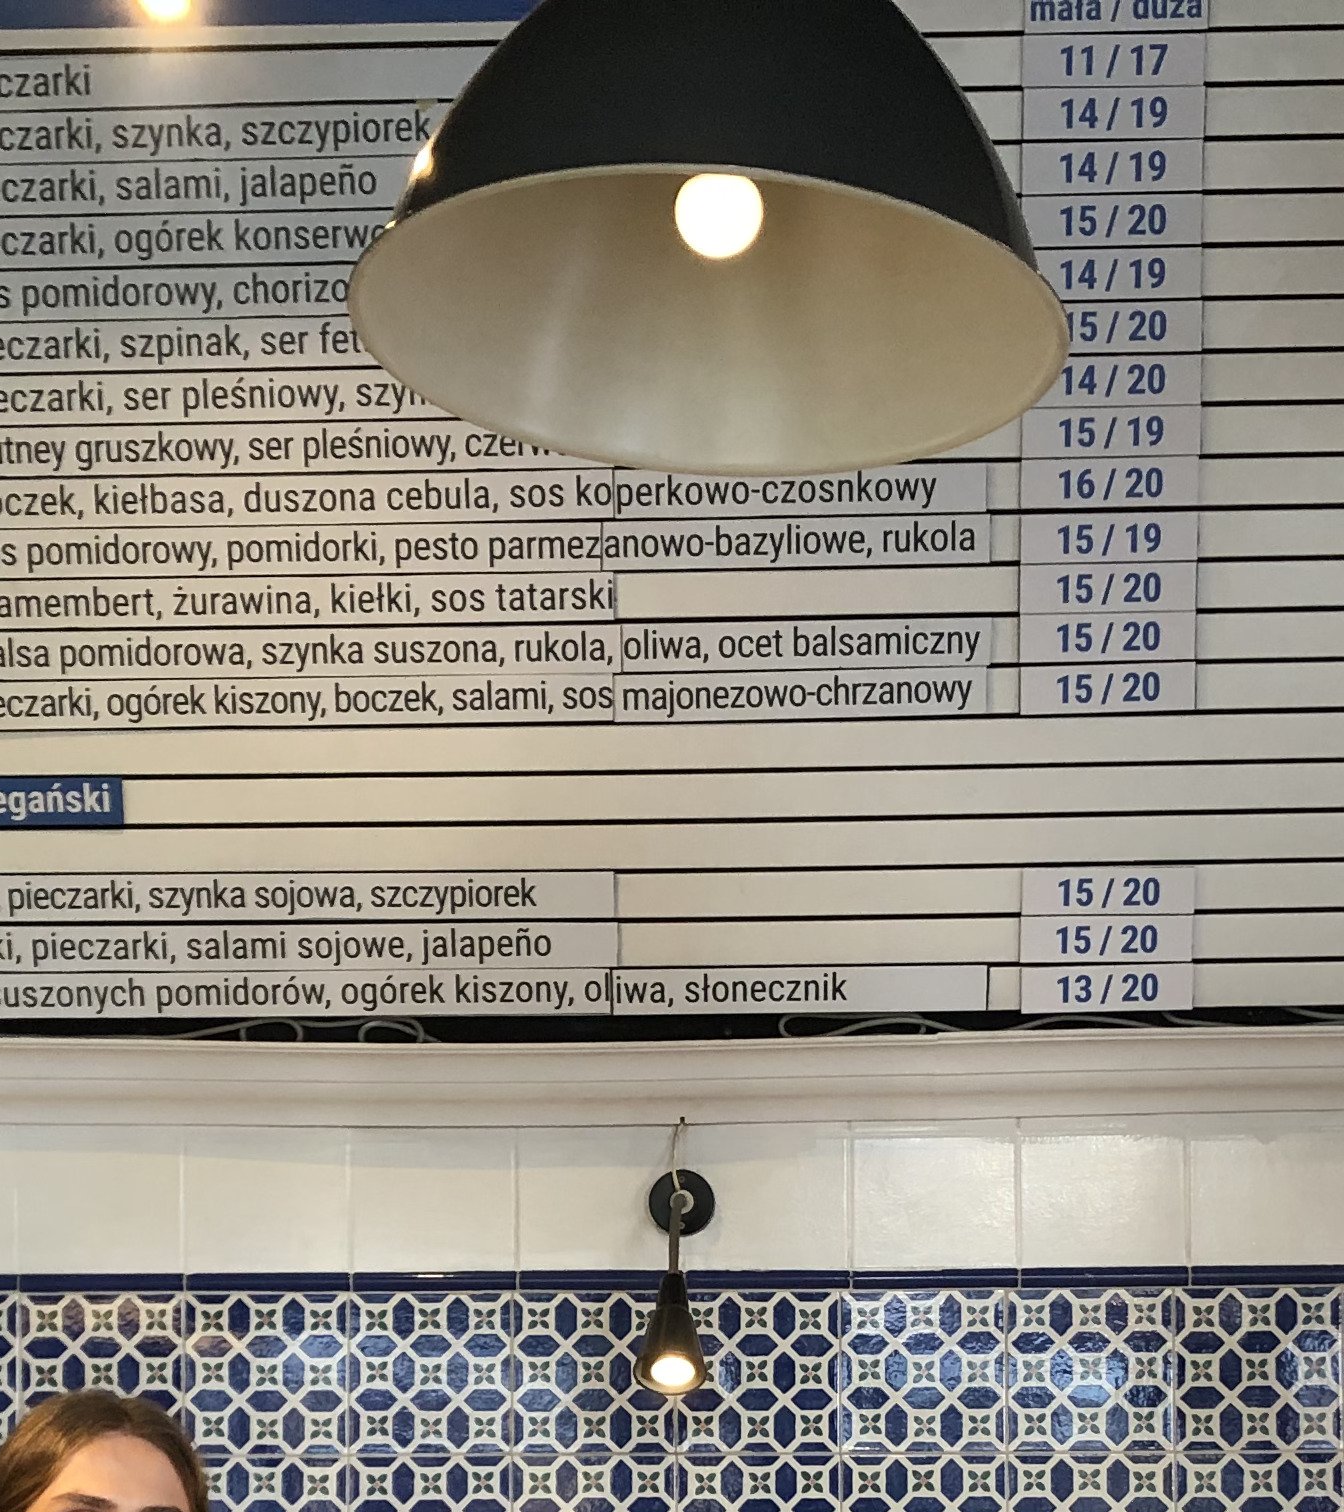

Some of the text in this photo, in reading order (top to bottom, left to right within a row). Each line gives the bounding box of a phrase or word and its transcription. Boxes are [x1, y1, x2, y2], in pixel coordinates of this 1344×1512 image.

[1059, 45, 1094, 77] 11
[1130, 43, 1169, 77] 17
[112, 115, 232, 157] szynka,
[241, 111, 432, 154] szczypiorek
[115, 168, 230, 206] salami,
[239, 165, 377, 207] jalapeño
[93, 480, 234, 518] kiełbasa,
[243, 478, 376, 511] duszona
[386, 476, 499, 514] cebula,
[509, 484, 565, 507] sos
[575, 470, 937, 515] koperkowo-czosnkowy
[26, 530, 218, 572] pomidorowy,
[226, 528, 386, 570] pomidorki,
[394, 530, 479, 567] pesto
[488, 520, 873, 566] parmezanowo-bazyliowe,
[882, 519, 976, 551] rukola
[59, 633, 253, 675] pomidorowa,
[262, 632, 364, 672] szynka
[373, 639, 505, 668] suszona,
[514, 629, 613, 666] rukola,
[624, 628, 709, 665] oliwa,
[718, 630, 784, 658] ocet
[793, 624, 981, 666] balsamiczny
[7, 878, 141, 919] pieczarki,
[148, 877, 247, 918] szynka
[254, 885, 363, 917] sojowa,
[370, 875, 537, 916] szczypiorek
[156, 974, 332, 1015] pomidorów,
[341, 973, 446, 1013] ogórek
[455, 972, 576, 1012] kiszony,
[584, 971, 675, 1008] oliwa,
[684, 969, 848, 1001] słonecznik
